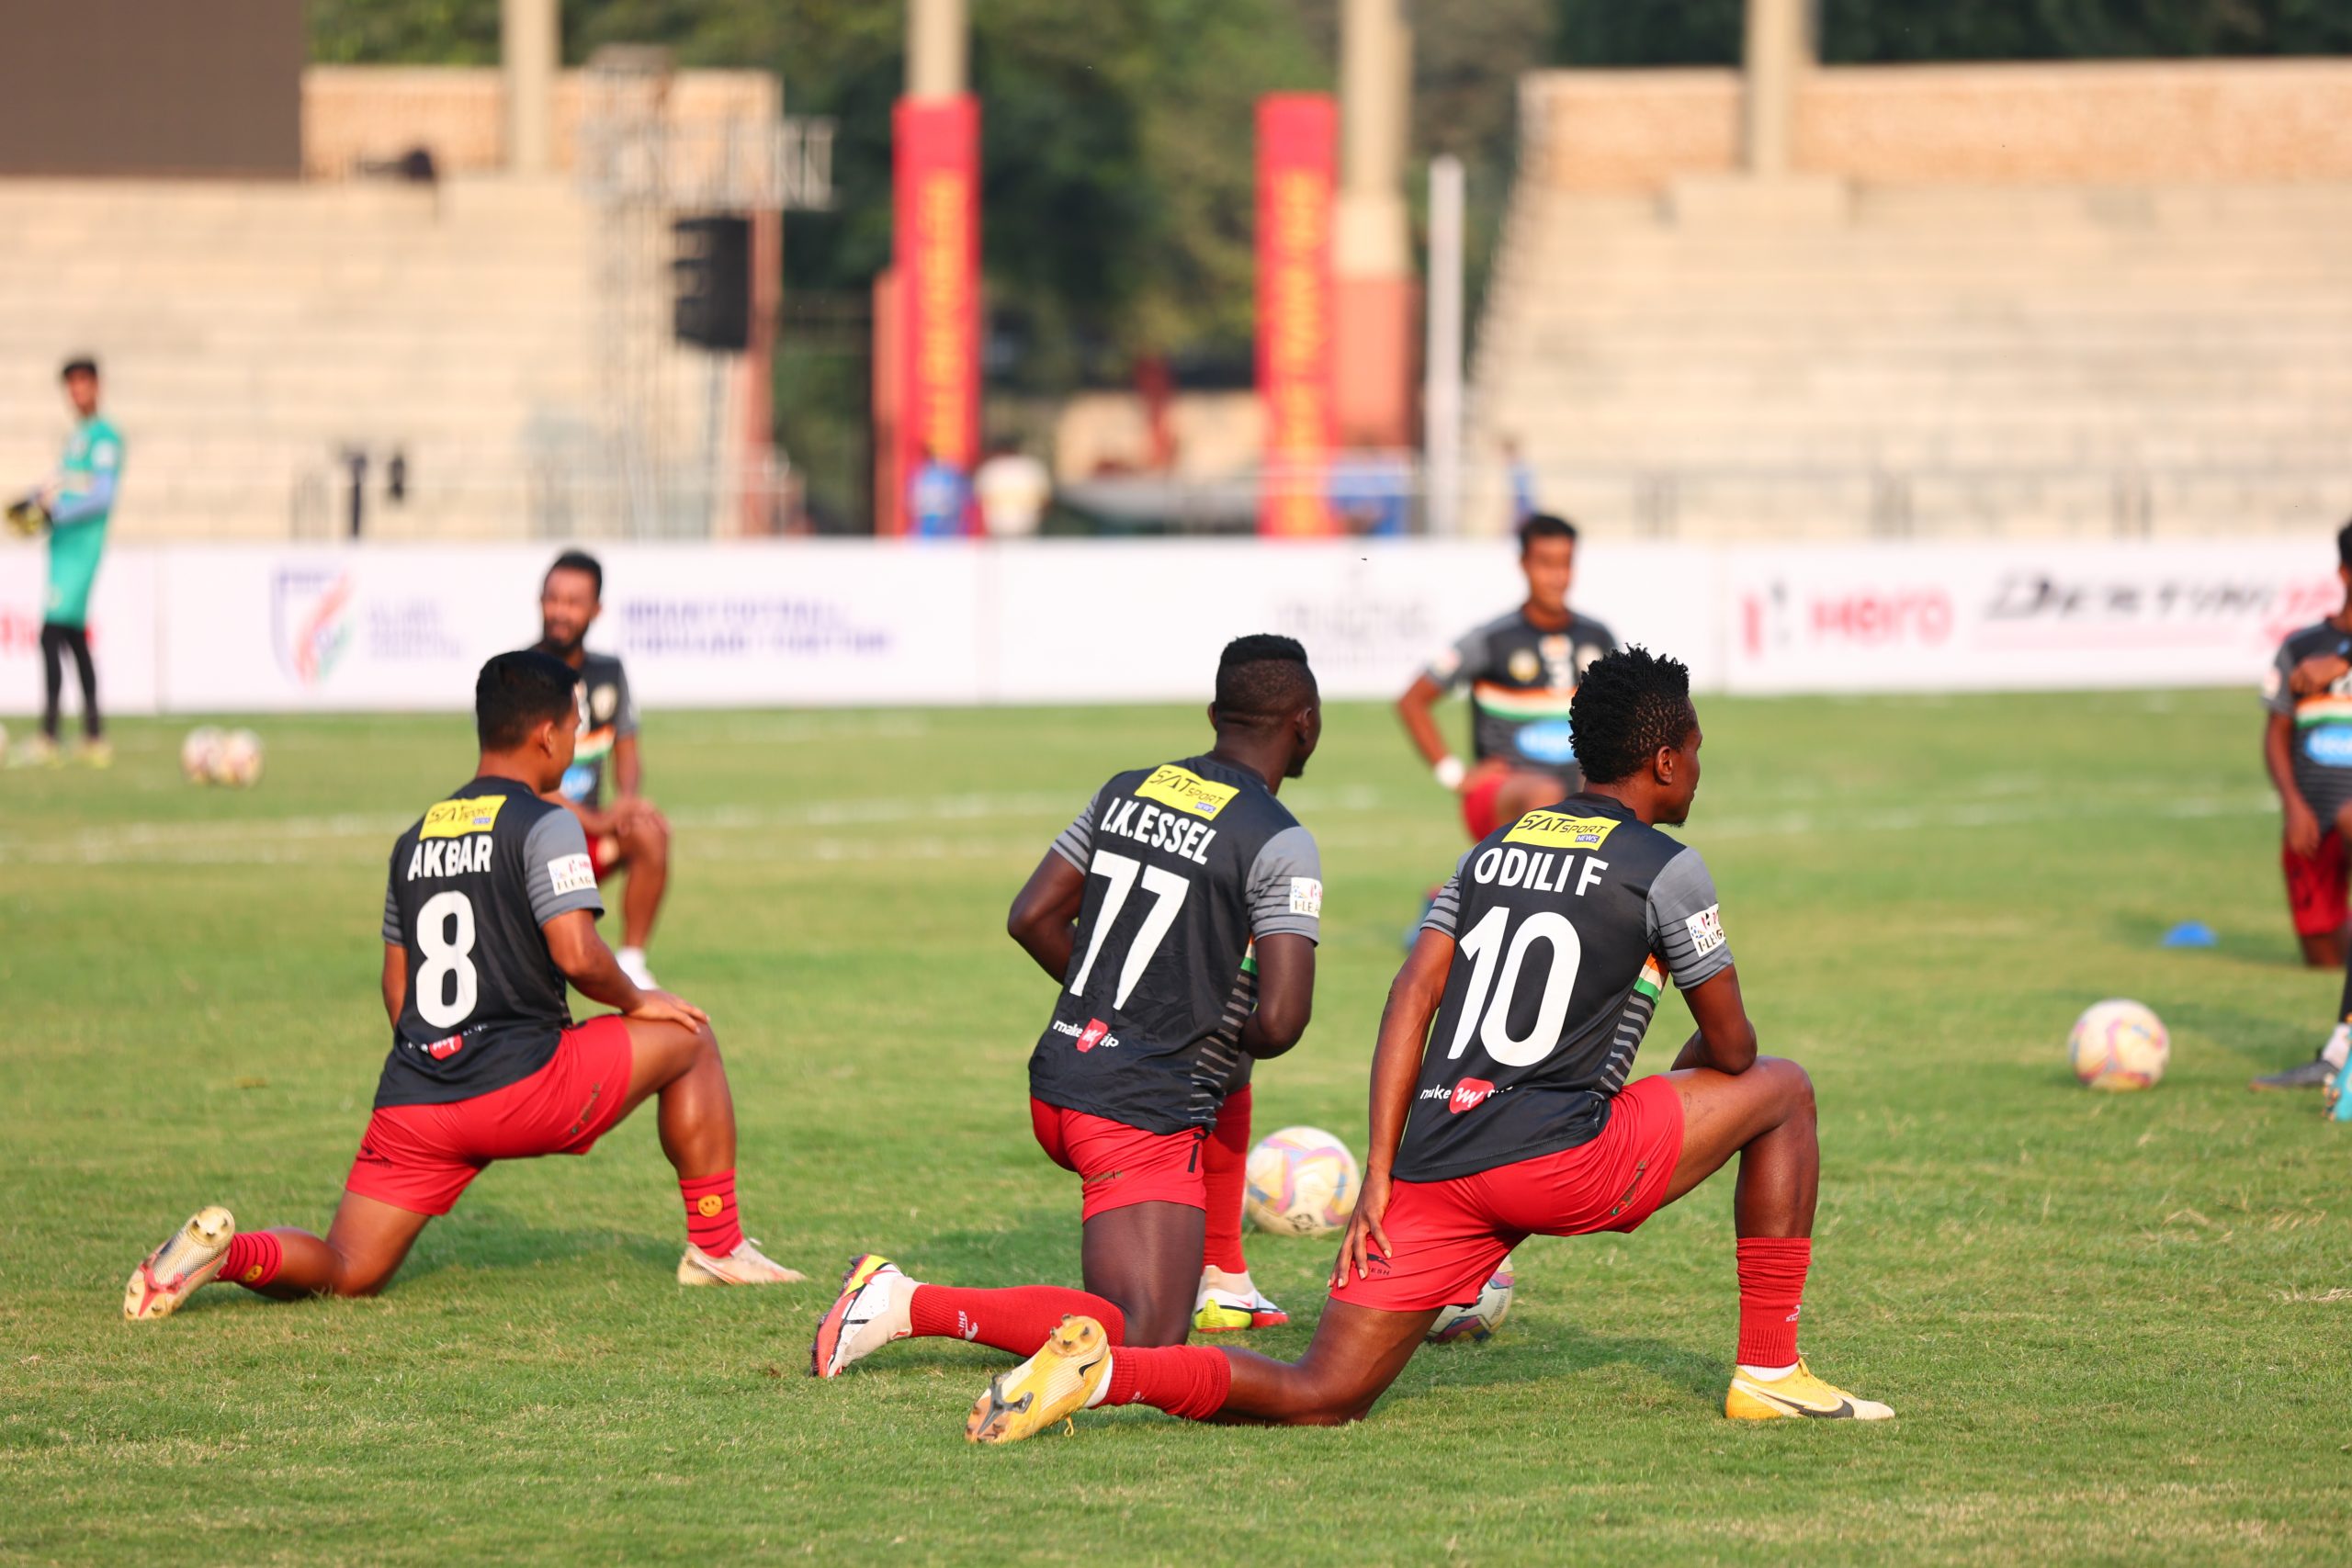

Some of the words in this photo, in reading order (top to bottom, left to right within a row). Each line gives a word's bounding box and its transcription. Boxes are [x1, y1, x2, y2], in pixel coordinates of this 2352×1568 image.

[408, 835, 493, 881] AKBAR
[1100, 797, 1218, 865] I.K.ESSEL
[1575, 834, 1600, 843] NEWS
[1474, 847, 1575, 893] ODILI
[1576, 855, 1610, 897] F
[416, 891, 477, 1028] 8
[1069, 850, 1191, 1010] 77
[1447, 907, 1580, 1067] 10
[1052, 1020, 1084, 1038] make
